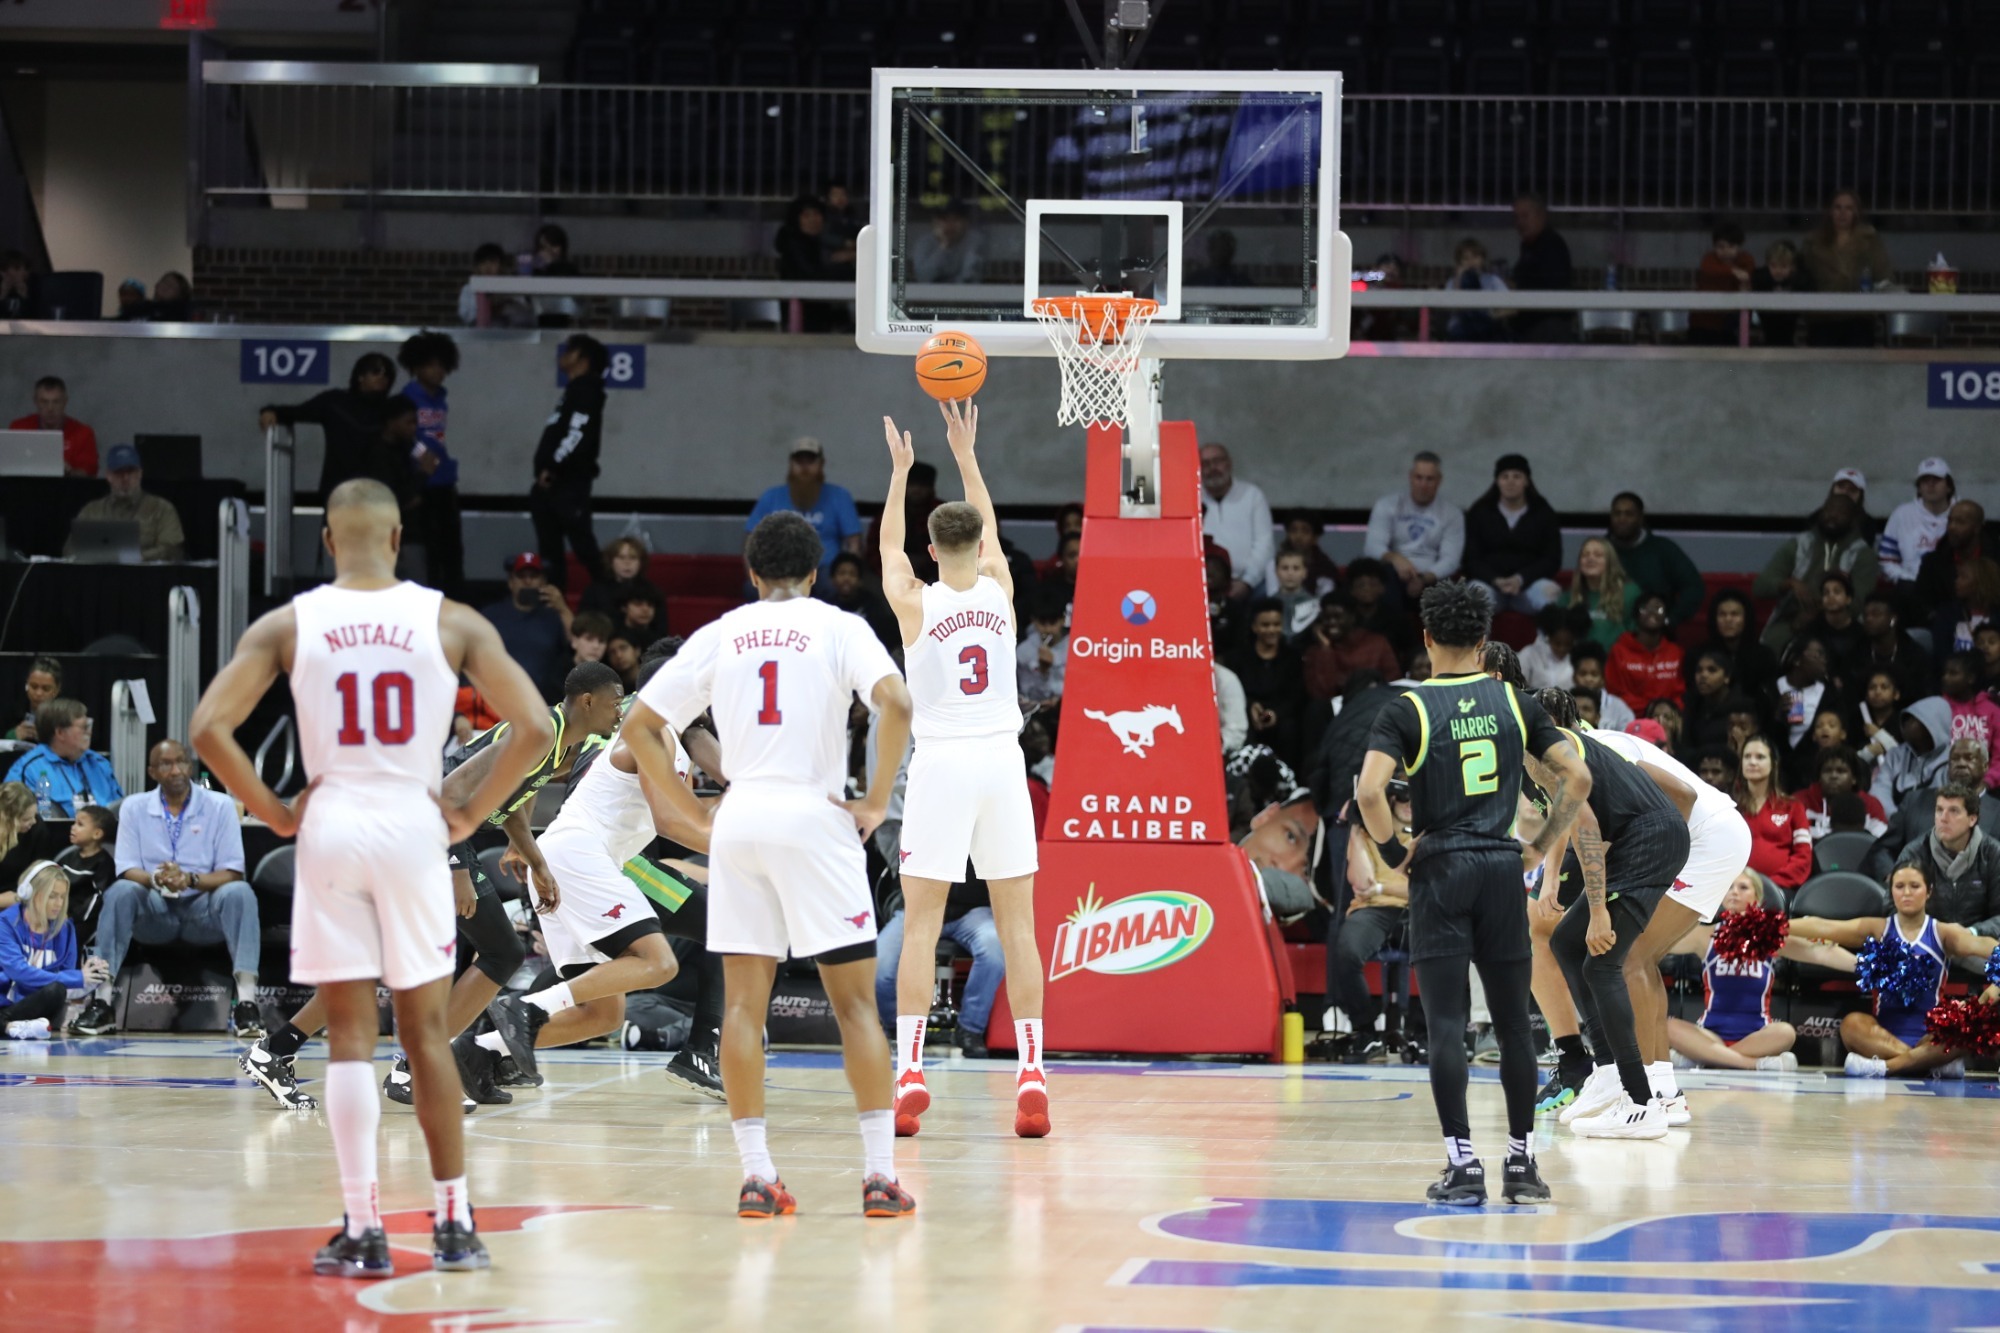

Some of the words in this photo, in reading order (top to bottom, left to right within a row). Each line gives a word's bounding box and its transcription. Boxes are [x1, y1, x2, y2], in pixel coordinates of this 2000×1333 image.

[888, 323, 933, 334] SPALDING
[254, 347, 317, 376] 107
[1940, 370, 2000, 401] 108
[324, 624, 414, 653] NUTALL
[928, 610, 1006, 643] TODOROVIC
[733, 629, 811, 654] PHELPS
[1073, 636, 1142, 663] Origin
[1150, 638, 1205, 659] Bank
[958, 644, 989, 695] 3
[758, 660, 782, 725] 1
[336, 671, 415, 746] 10
[1450, 714, 1499, 740] HARRIS
[1459, 738, 1499, 796] 2
[1081, 794, 1192, 814] GRAND
[1063, 818, 1207, 840] CALIBER
[1049, 903, 1201, 981] LIBMAN
[144, 983, 183, 994] AUTO
[771, 995, 811, 1008] AUTO
[1797, 1025, 1838, 1038] SCOPE
